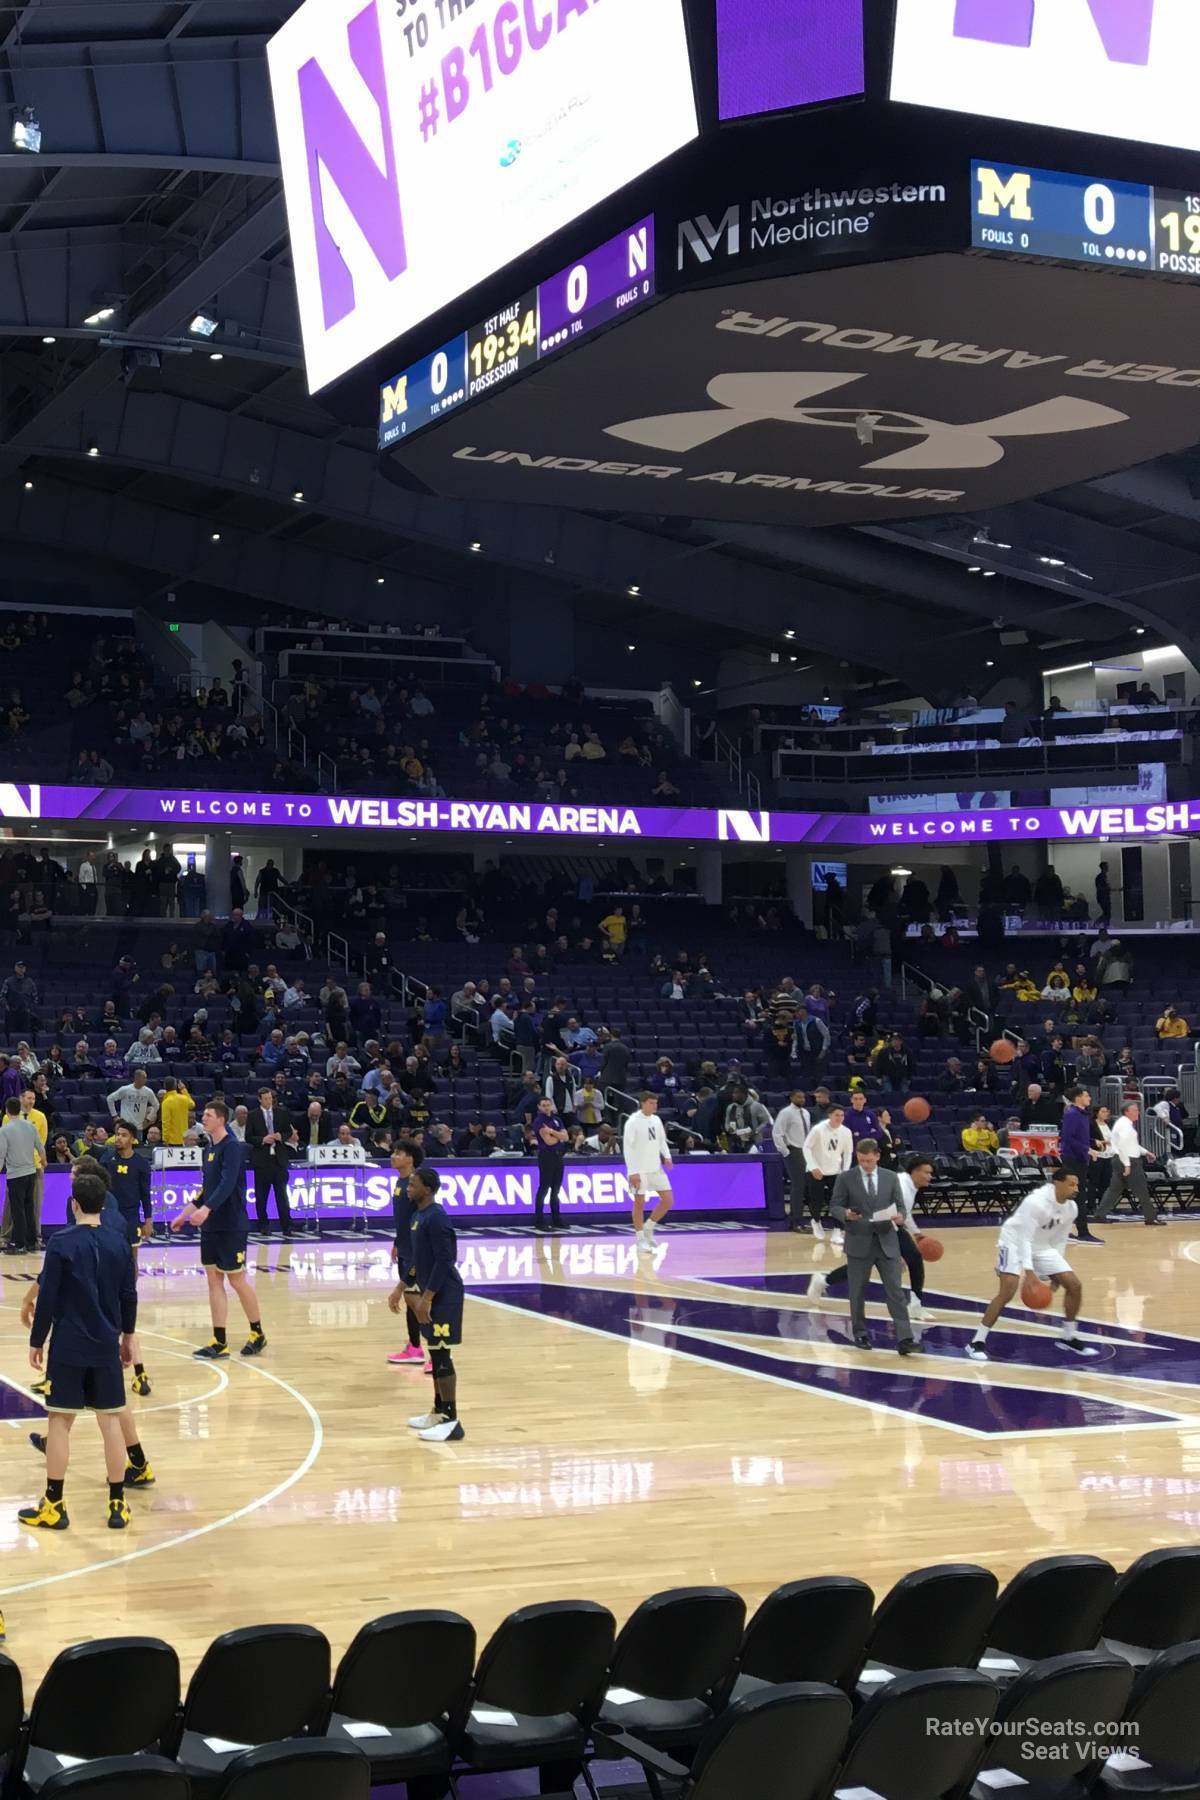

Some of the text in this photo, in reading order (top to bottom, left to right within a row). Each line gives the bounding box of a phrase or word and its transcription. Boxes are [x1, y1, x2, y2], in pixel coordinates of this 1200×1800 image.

[403, 12, 429, 58] TO
[751, 182, 946, 222] Northwestern
[977, 167, 1032, 221] M
[1083, 183, 1115, 236] 0
[751, 212, 872, 250] Medicine
[981, 228, 1029, 248] FOULS 0
[1082, 242, 1101, 257] TOL
[628, 226, 647, 278] N
[566, 264, 588, 314] 0
[616, 280, 649, 309] FOULS 0
[484, 302, 520, 335] 1ST HALF
[571, 320, 584, 334] TOL
[470, 310, 537, 377] 19:34
[431, 351, 448, 395] 0
[469, 356, 519, 396] POSSESSION
[382, 374, 408, 424] M
[431, 402, 441, 416] TOL
[384, 421, 406, 442] FOULS 0
[451, 445, 966, 501] UNDER ARMOUR
[160, 798, 642, 835] WELCOME TO WELSH-RYAN ARENA
[870, 817, 994, 837] WELCOME
[1010, 817, 1041, 831] TO
[648, 1126, 657, 1141] N
[828, 1138, 839, 1151] N
[433, 1323, 450, 1337] M
